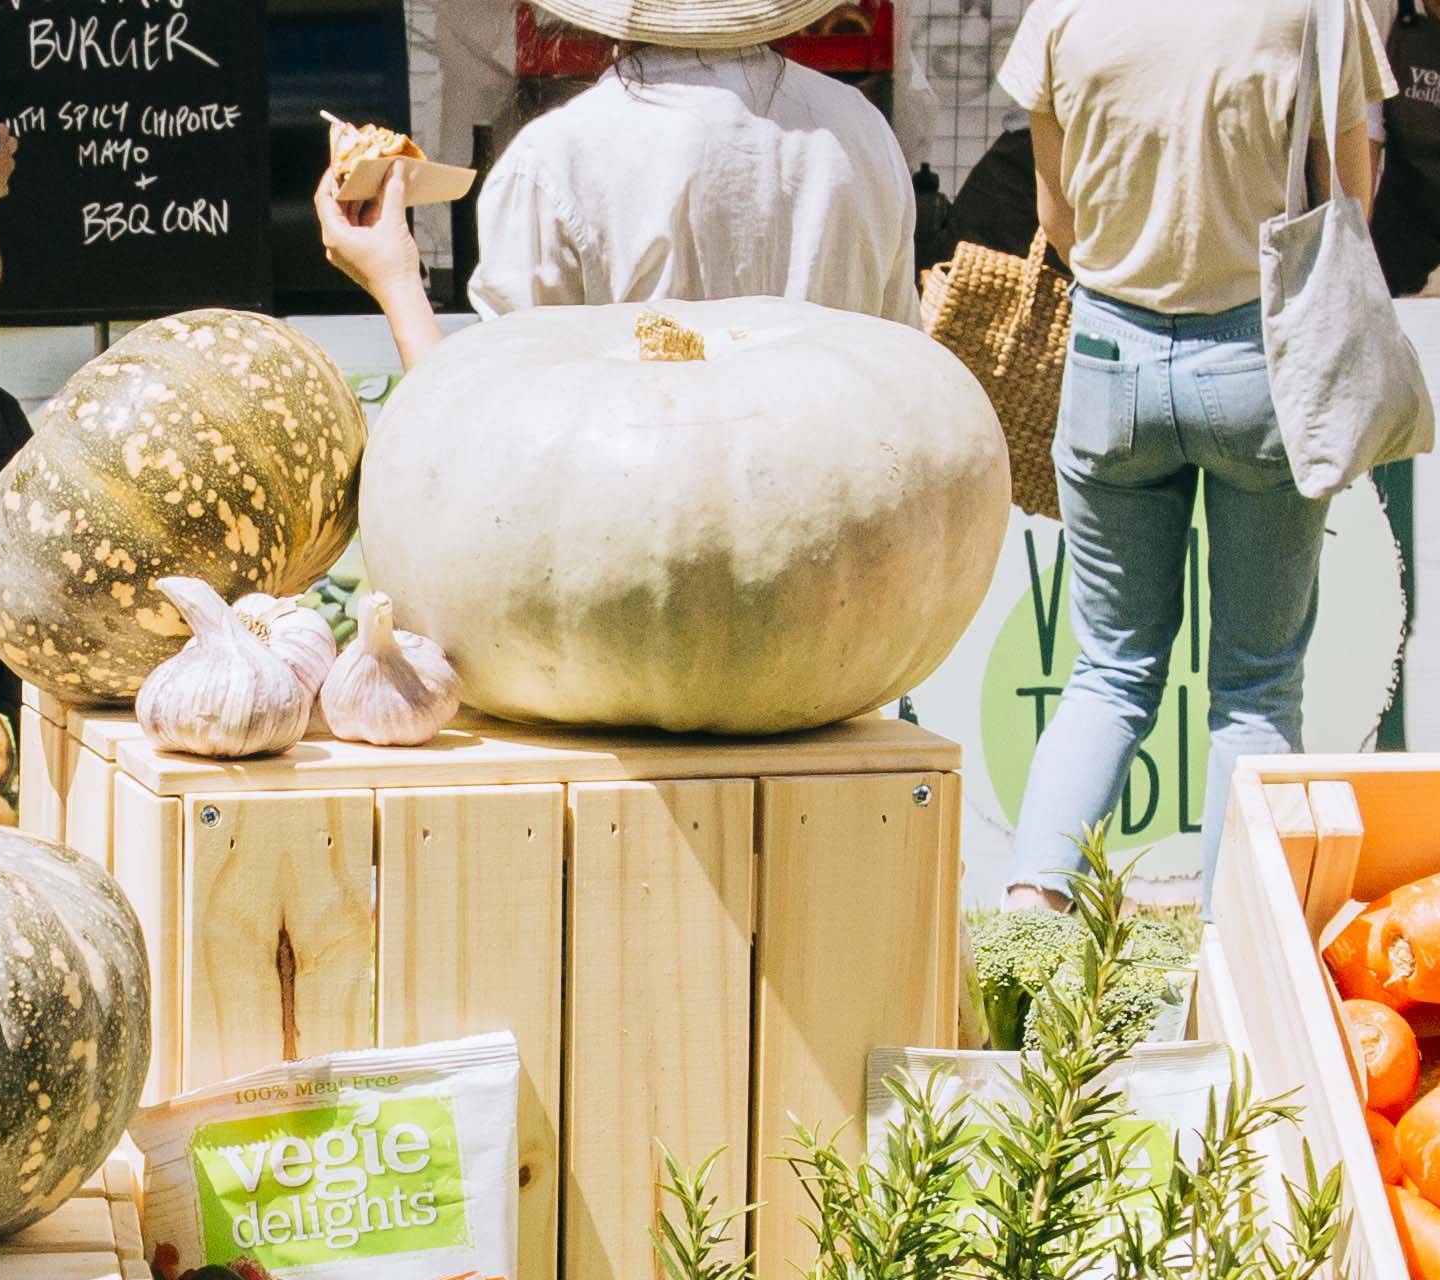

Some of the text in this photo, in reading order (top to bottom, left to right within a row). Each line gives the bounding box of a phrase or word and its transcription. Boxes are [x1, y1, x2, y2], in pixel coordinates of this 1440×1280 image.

[28, 12, 220, 70] BURGER
[58, 100, 129, 133] SPICY
[140, 104, 242, 138] CHIPOTLE
[78, 137, 150, 170] MAYO
[81, 198, 230, 245] BBQ CORN
[234, 1073, 400, 1105] 100% Meat Free
[220, 1104, 432, 1201] vegie
[231, 1183, 438, 1249] delights
